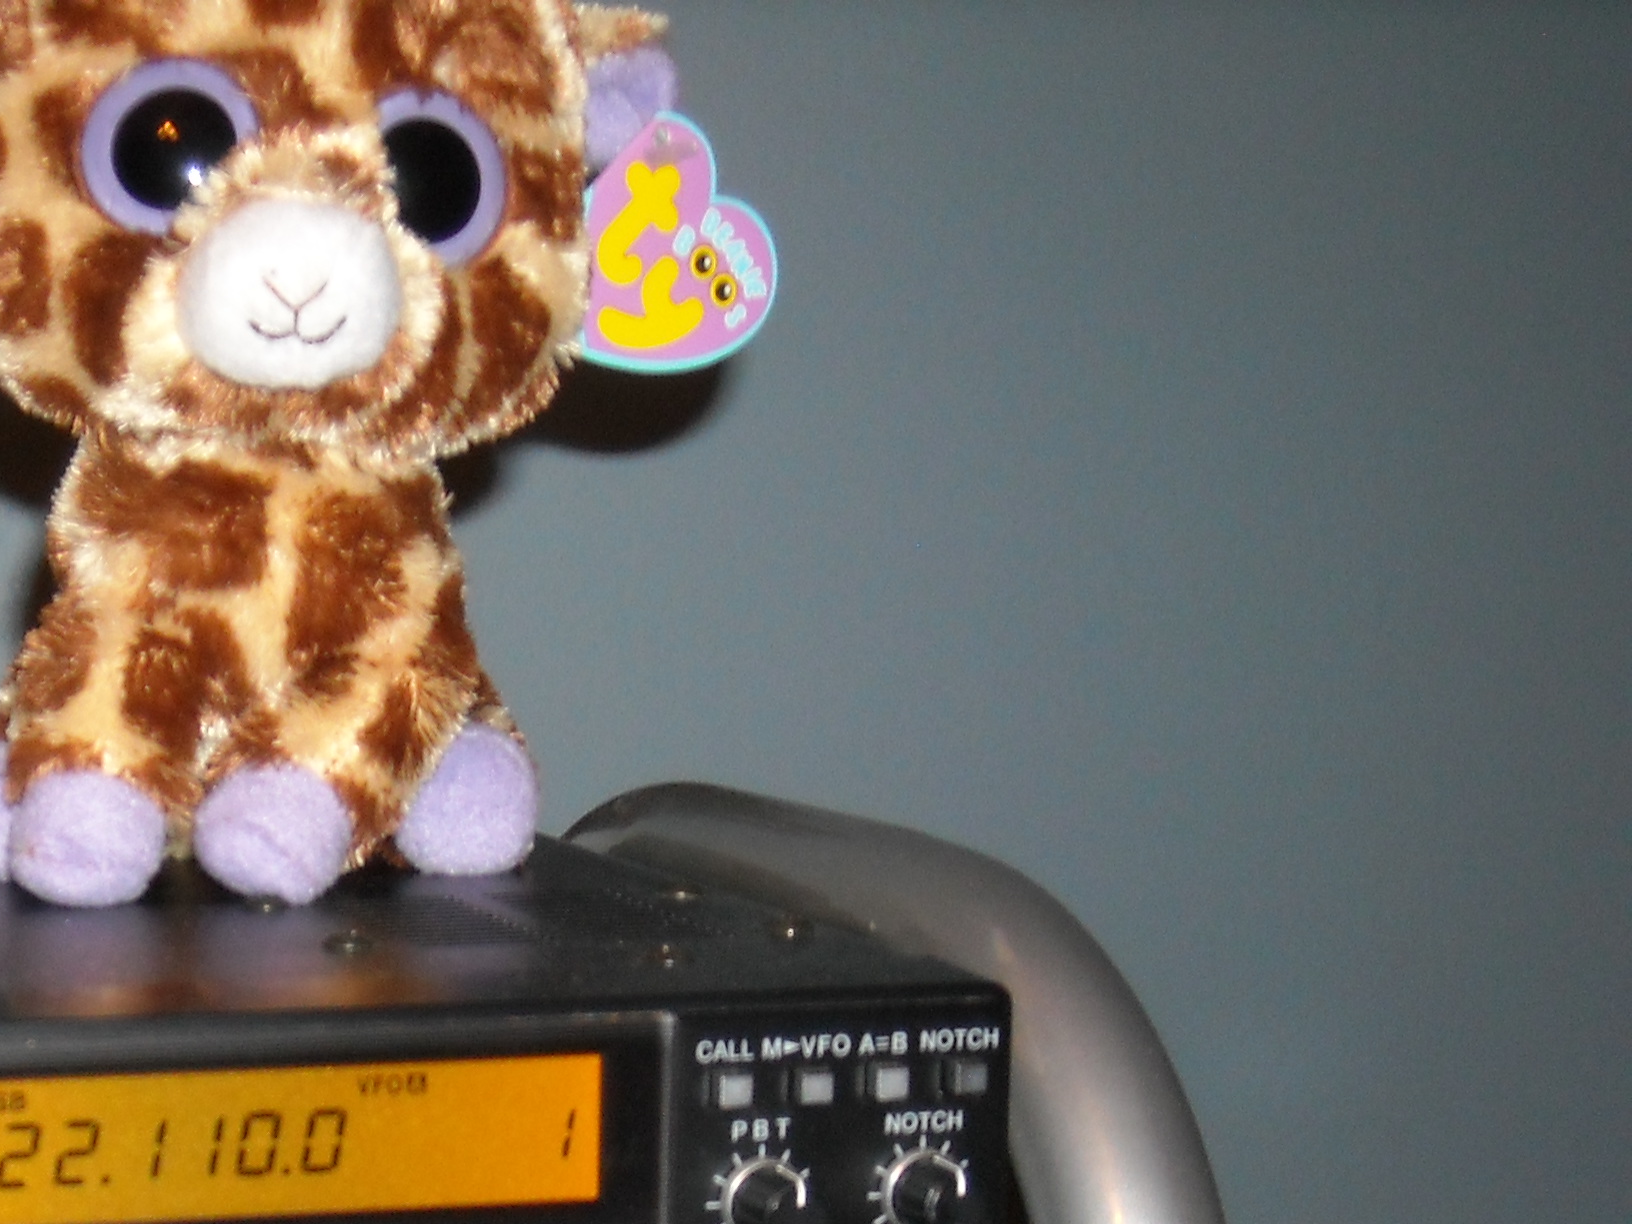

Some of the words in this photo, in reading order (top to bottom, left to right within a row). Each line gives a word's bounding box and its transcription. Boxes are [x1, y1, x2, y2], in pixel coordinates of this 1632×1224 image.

[696, 1038, 754, 1063] CALL
[858, 1031, 908, 1056] A=B
[920, 1027, 1000, 1052] NOTCH
[884, 1109, 965, 1135] NOTCH
